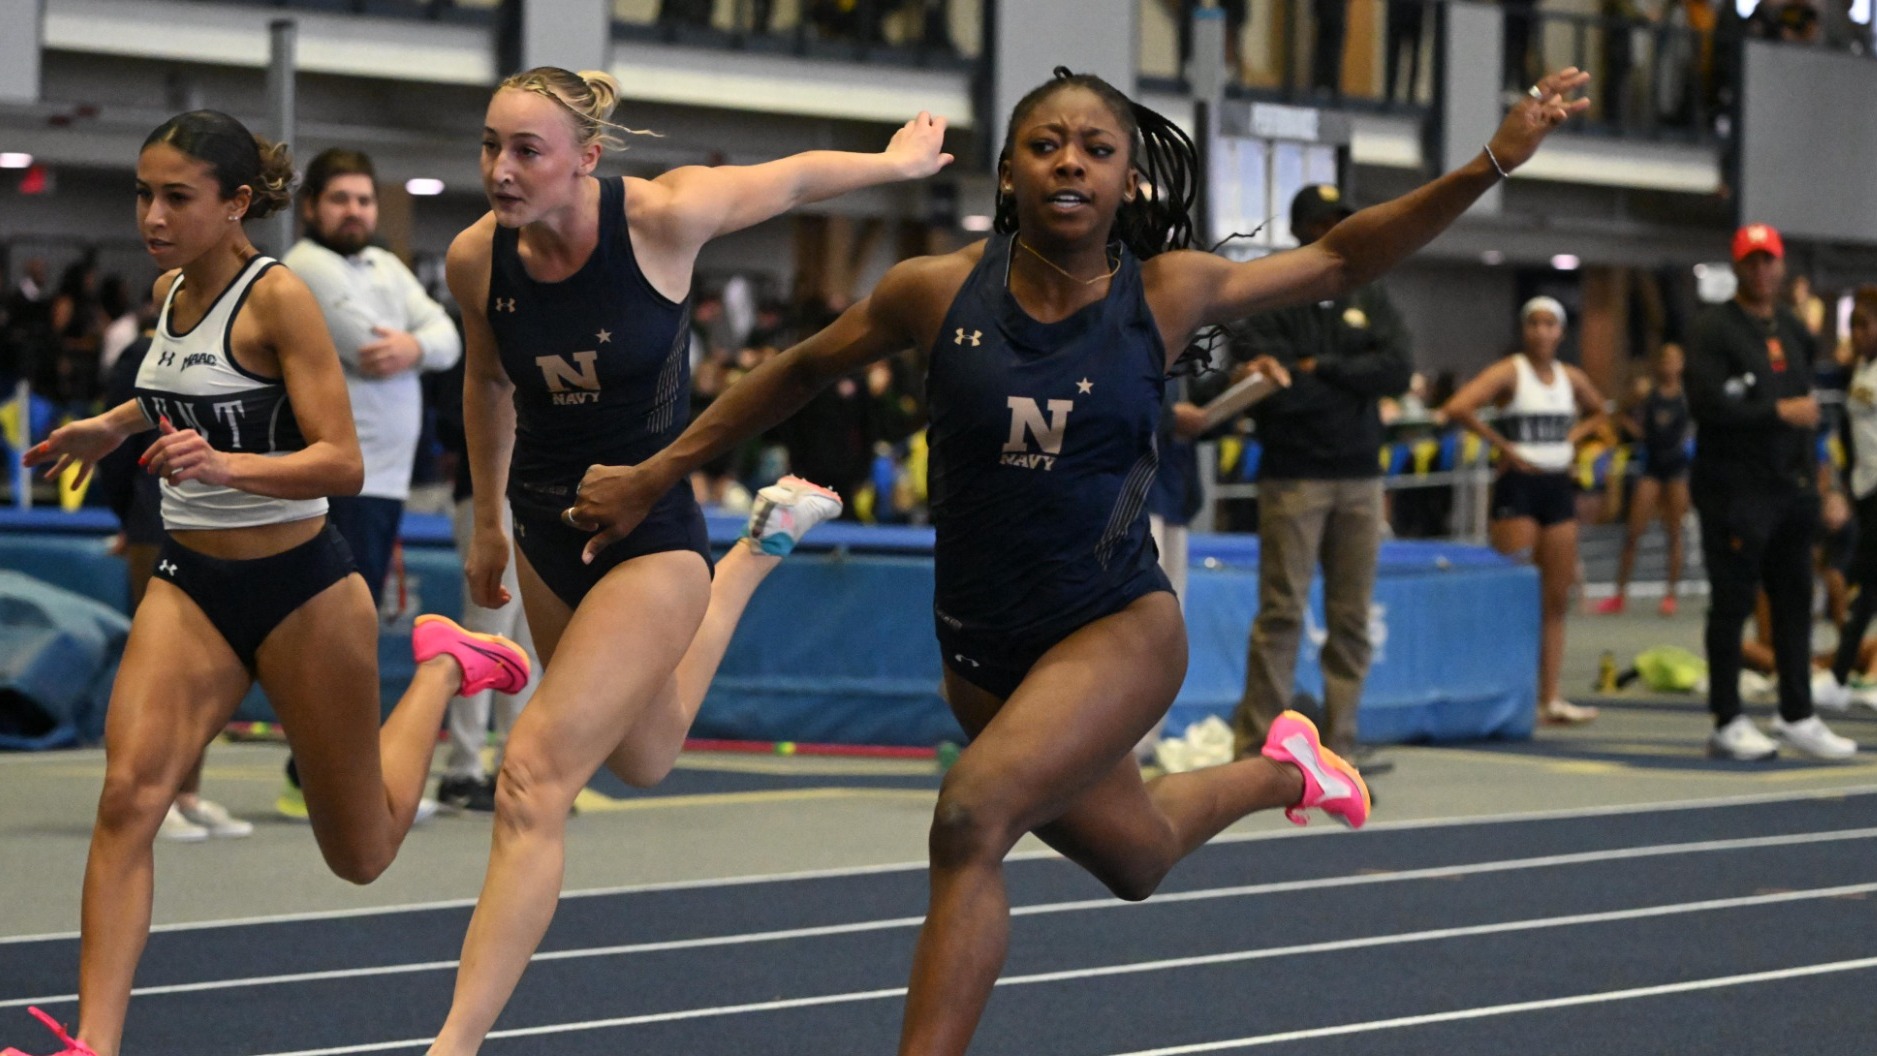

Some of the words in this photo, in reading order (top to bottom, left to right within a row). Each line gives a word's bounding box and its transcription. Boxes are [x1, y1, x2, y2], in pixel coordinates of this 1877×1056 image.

[180, 353, 217, 372] MAAC
[535, 350, 601, 393] N
[552, 391, 600, 405] NAVY
[1002, 395, 1074, 455] N
[1000, 453, 1057, 471] NAVY
